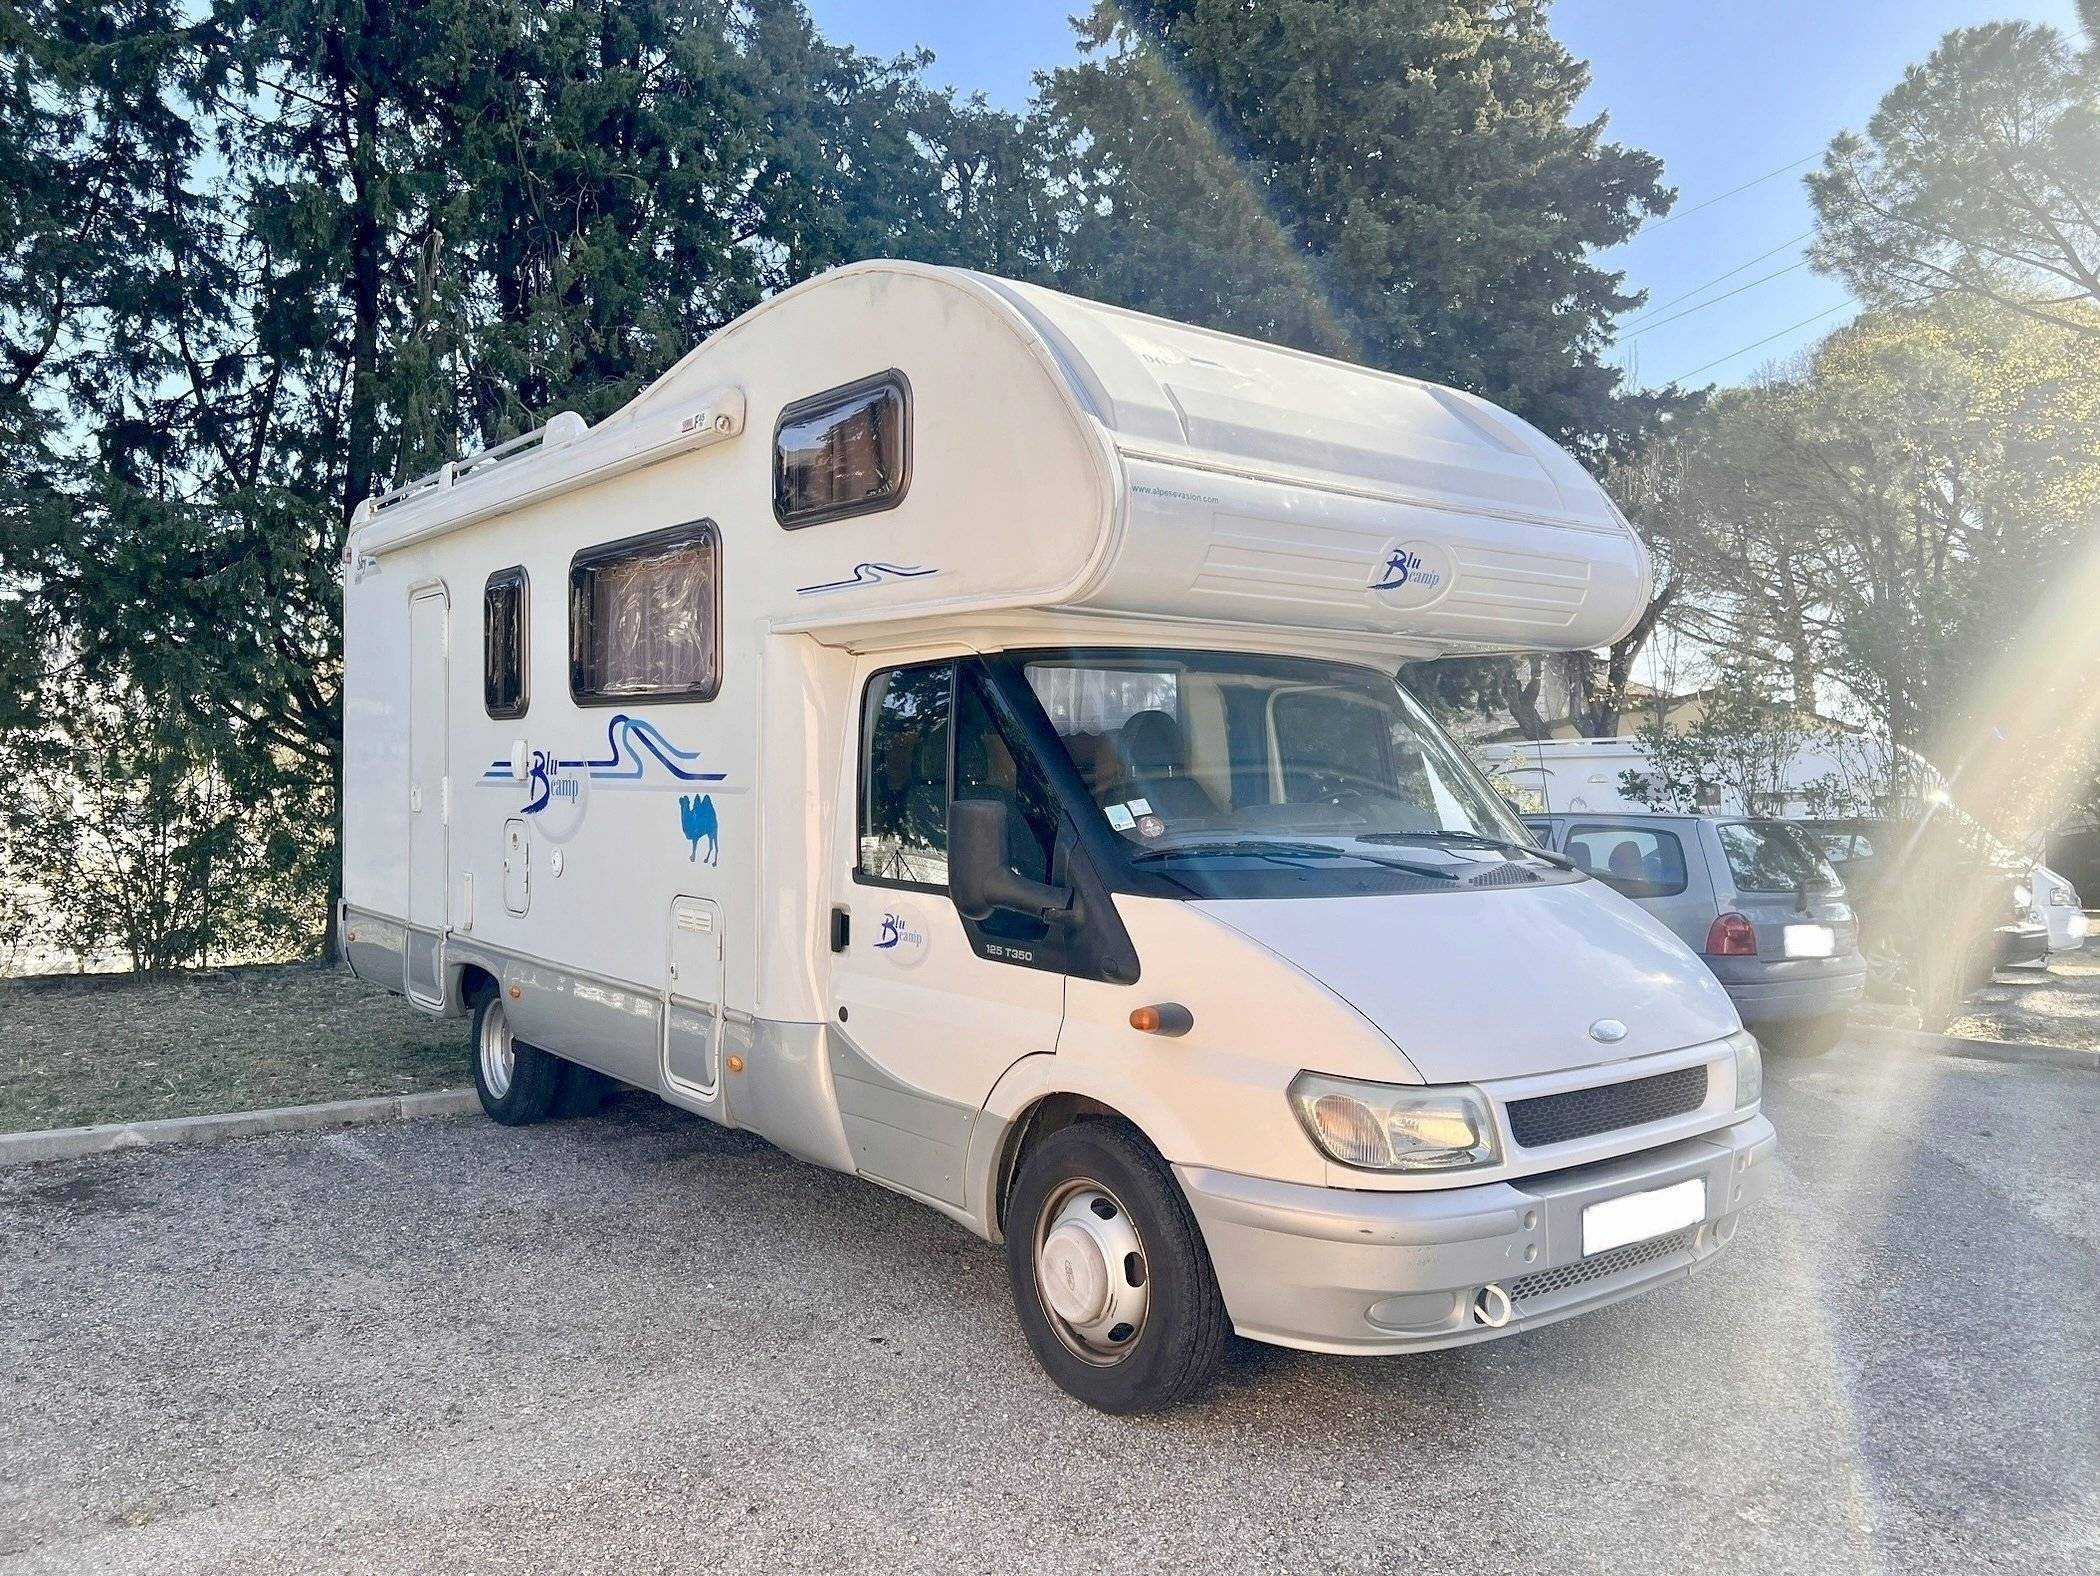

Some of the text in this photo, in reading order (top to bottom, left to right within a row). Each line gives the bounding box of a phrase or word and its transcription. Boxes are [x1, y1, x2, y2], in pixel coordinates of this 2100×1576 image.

[1366, 549, 1421, 590] Blu
[1408, 570, 1440, 589] camp
[520, 751, 558, 814] Blu
[551, 774, 579, 804] camp
[873, 913, 905, 949] Blu
[899, 930, 922, 947] camp
[986, 944, 1033, 962] 125 T350
